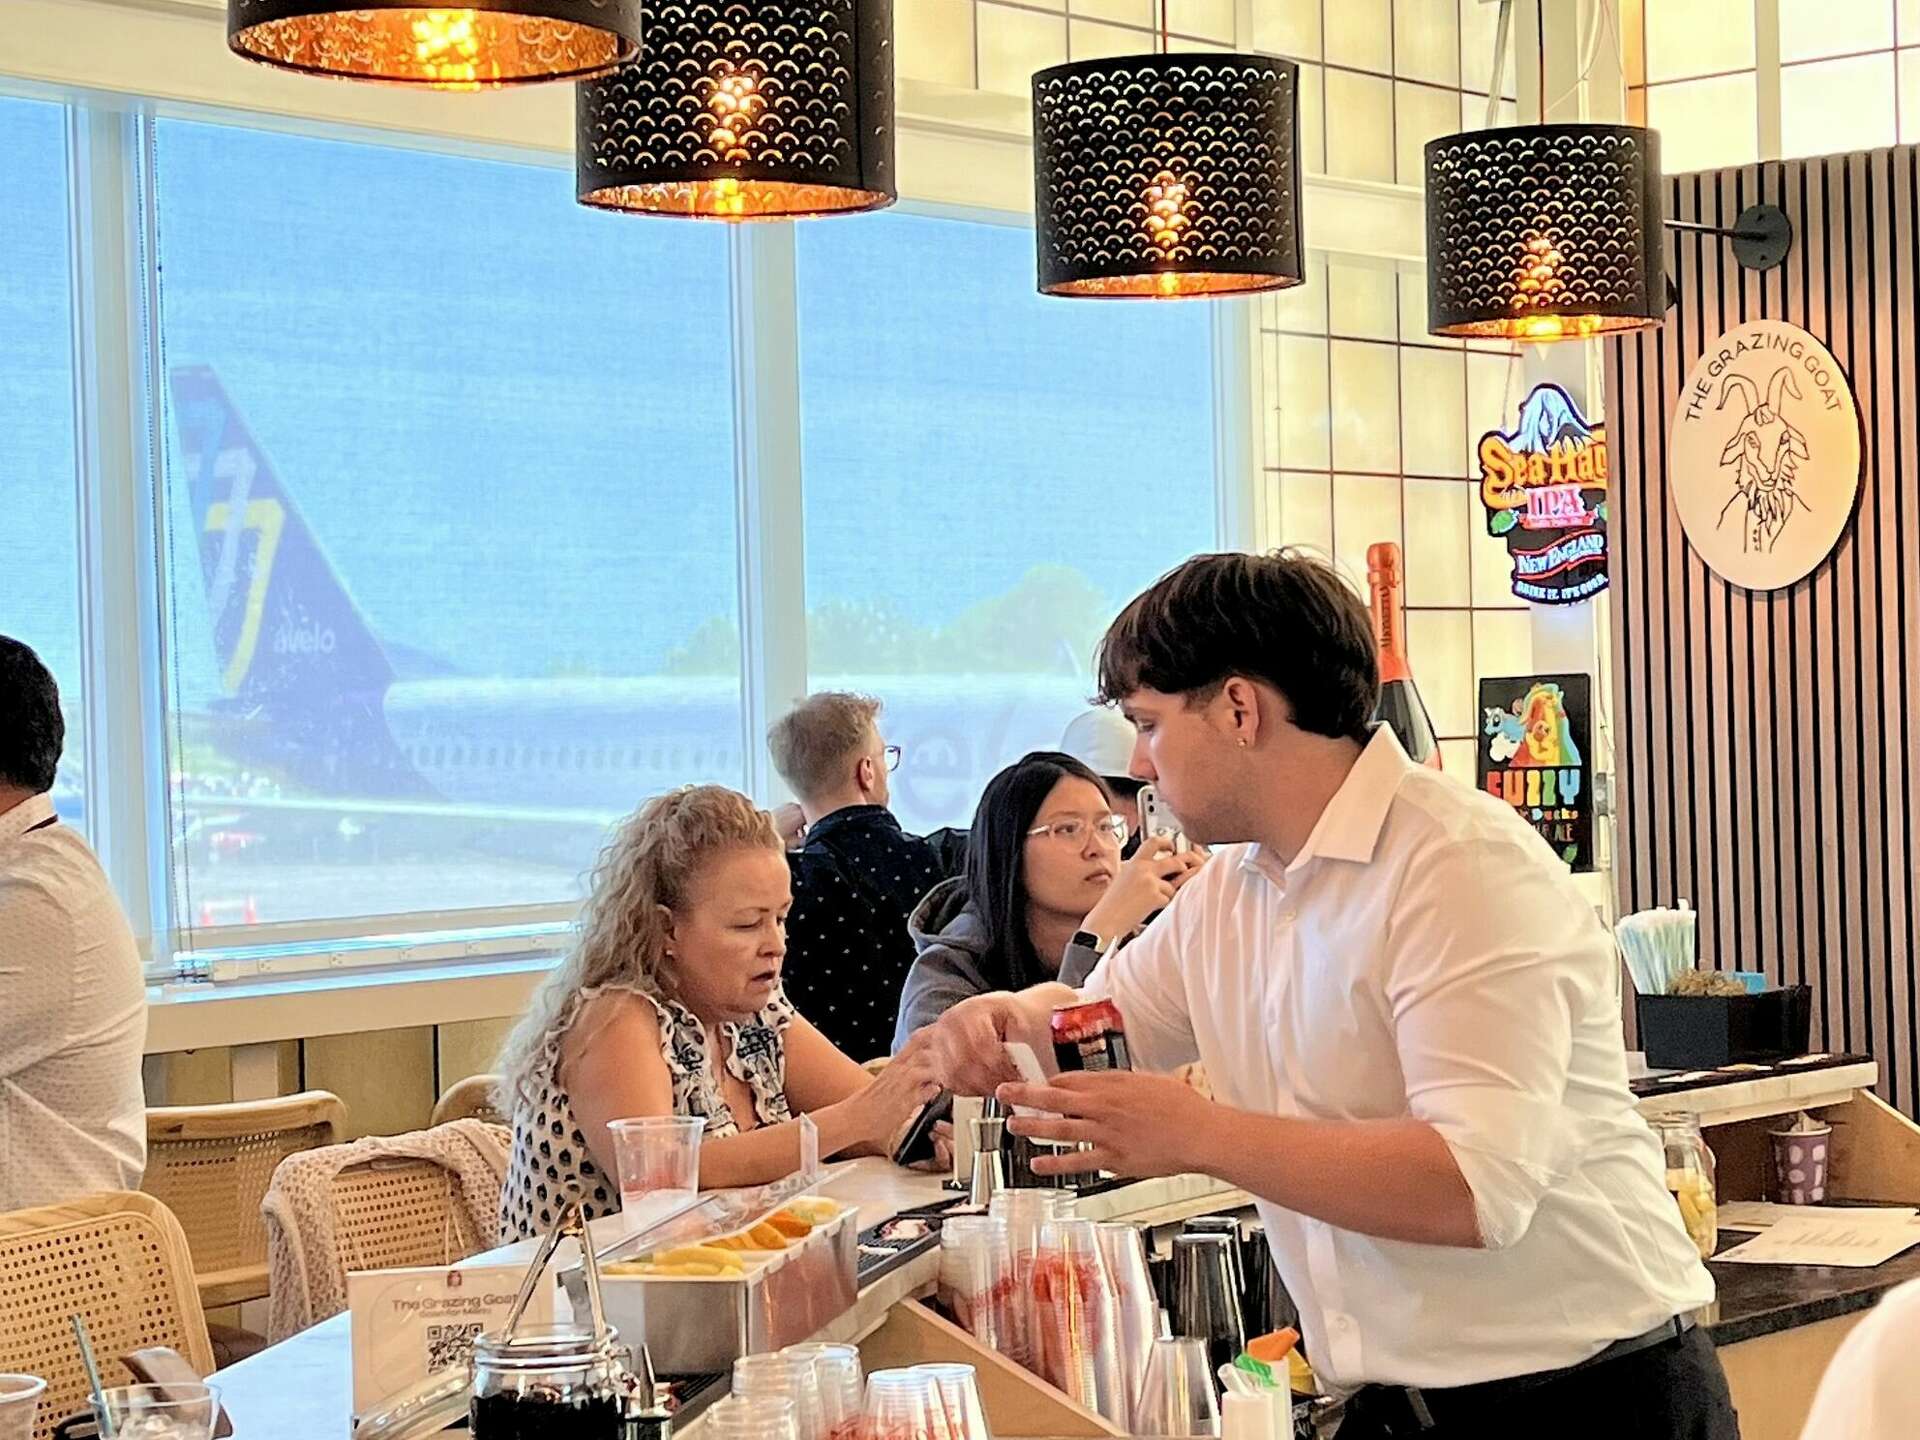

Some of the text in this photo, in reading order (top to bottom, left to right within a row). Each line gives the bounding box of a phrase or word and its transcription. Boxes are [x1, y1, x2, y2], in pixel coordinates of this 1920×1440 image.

[1685, 332, 1843, 423] THE GRAZING GOAT
[1480, 435, 1546, 509] Sea
[1528, 489, 1582, 516] IPA
[272, 620, 336, 654] avelo
[391, 1299, 420, 1313] The
[421, 1296, 481, 1310] Grazing
[483, 1293, 519, 1305] Goat
